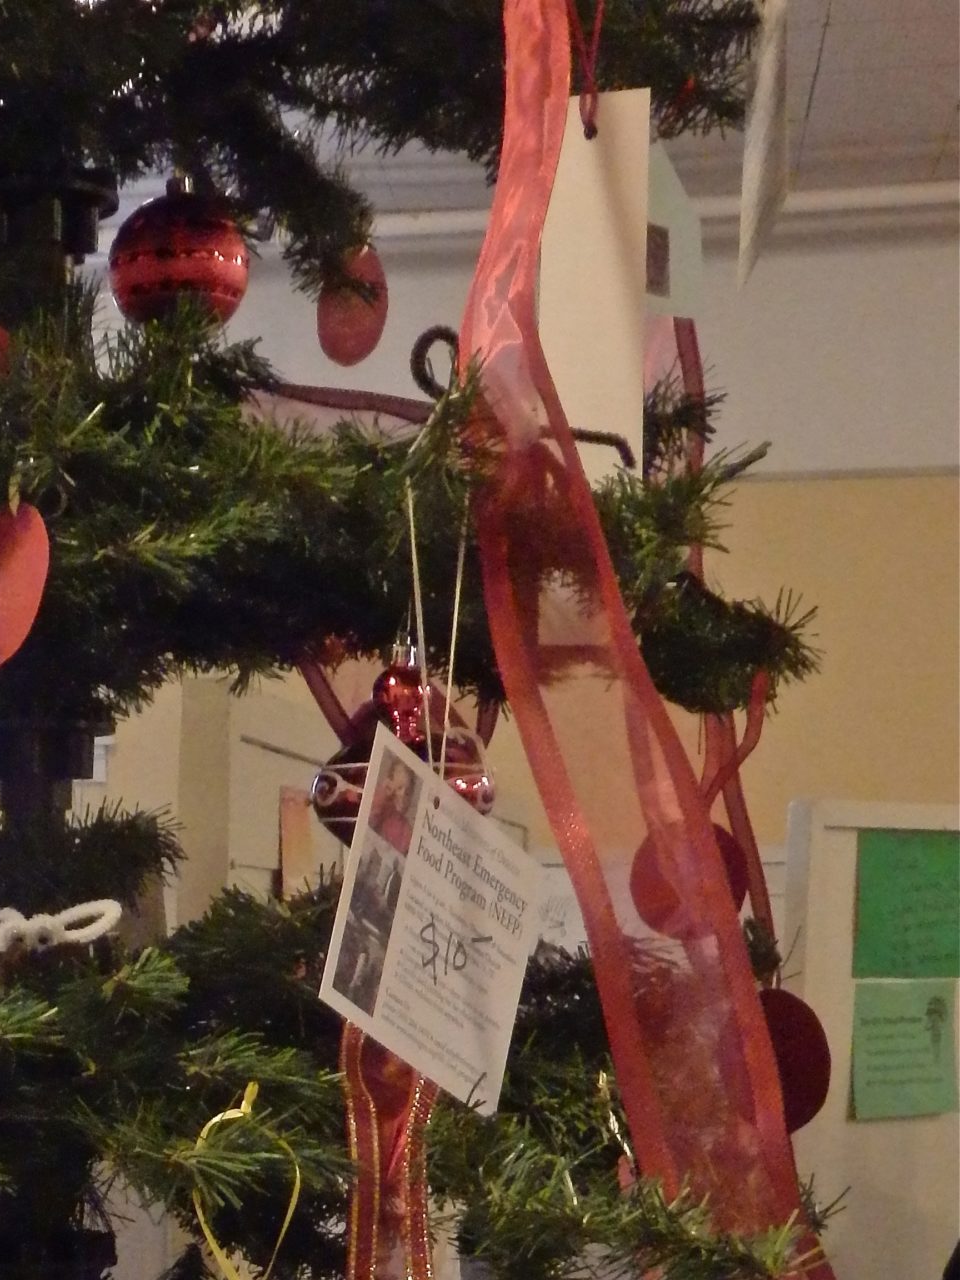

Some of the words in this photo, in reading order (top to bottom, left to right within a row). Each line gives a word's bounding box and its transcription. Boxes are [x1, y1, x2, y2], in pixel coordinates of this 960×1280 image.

[417, 836, 444, 872] Food
[444, 860, 487, 910] Program
[422, 809, 471, 867] Northeast
[472, 854, 528, 917] Emergency
